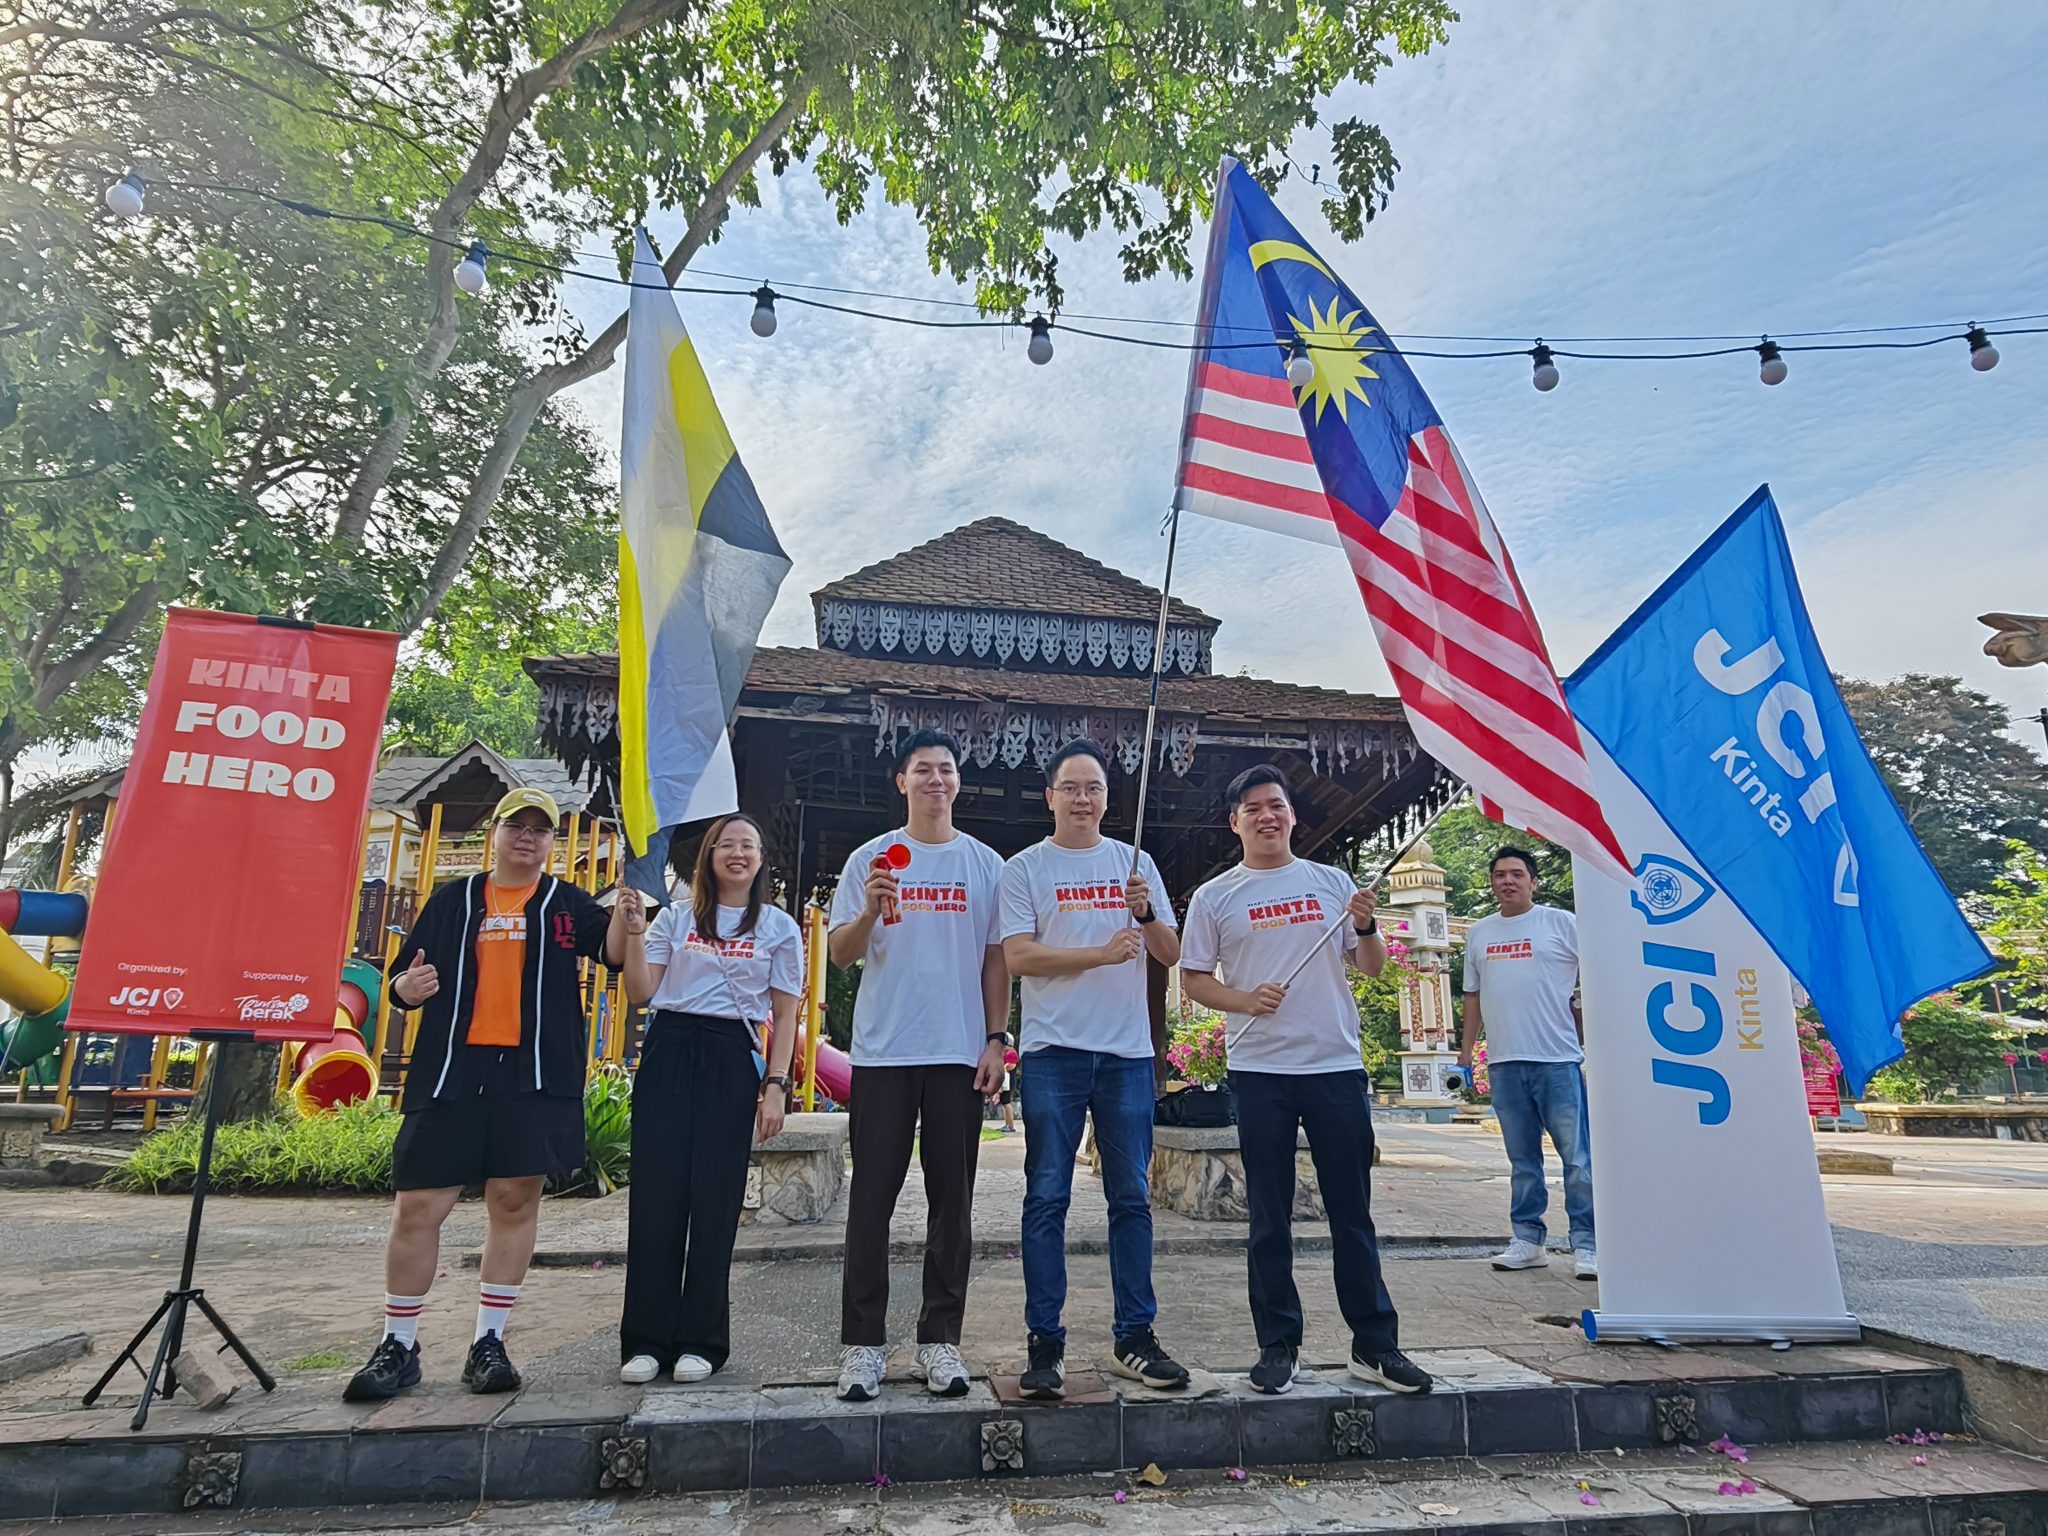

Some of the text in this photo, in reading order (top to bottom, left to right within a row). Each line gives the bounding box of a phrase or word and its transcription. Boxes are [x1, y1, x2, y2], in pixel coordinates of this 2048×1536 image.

[187, 658, 351, 704] KINTA
[175, 700, 346, 750] FOOD
[162, 751, 336, 802] HERO
[1709, 736, 1792, 838] Kinta
[901, 887, 967, 902] KINTA
[1055, 885, 1124, 902] KINTA
[901, 903, 967, 912] FOOD HERO
[1058, 900, 1126, 912] FOOD HERO
[1249, 899, 1322, 921] KINTA
[1252, 912, 1325, 931] FOOD HERO
[1486, 942, 1532, 954] KINTA
[117, 962, 170, 974] Organized
[243, 970, 293, 981] Supported
[109, 987, 161, 1007] JCI
[240, 1006, 295, 1021] perak
[1735, 968, 1765, 1051] Kinta
[1642, 941, 1731, 1125] JCI
